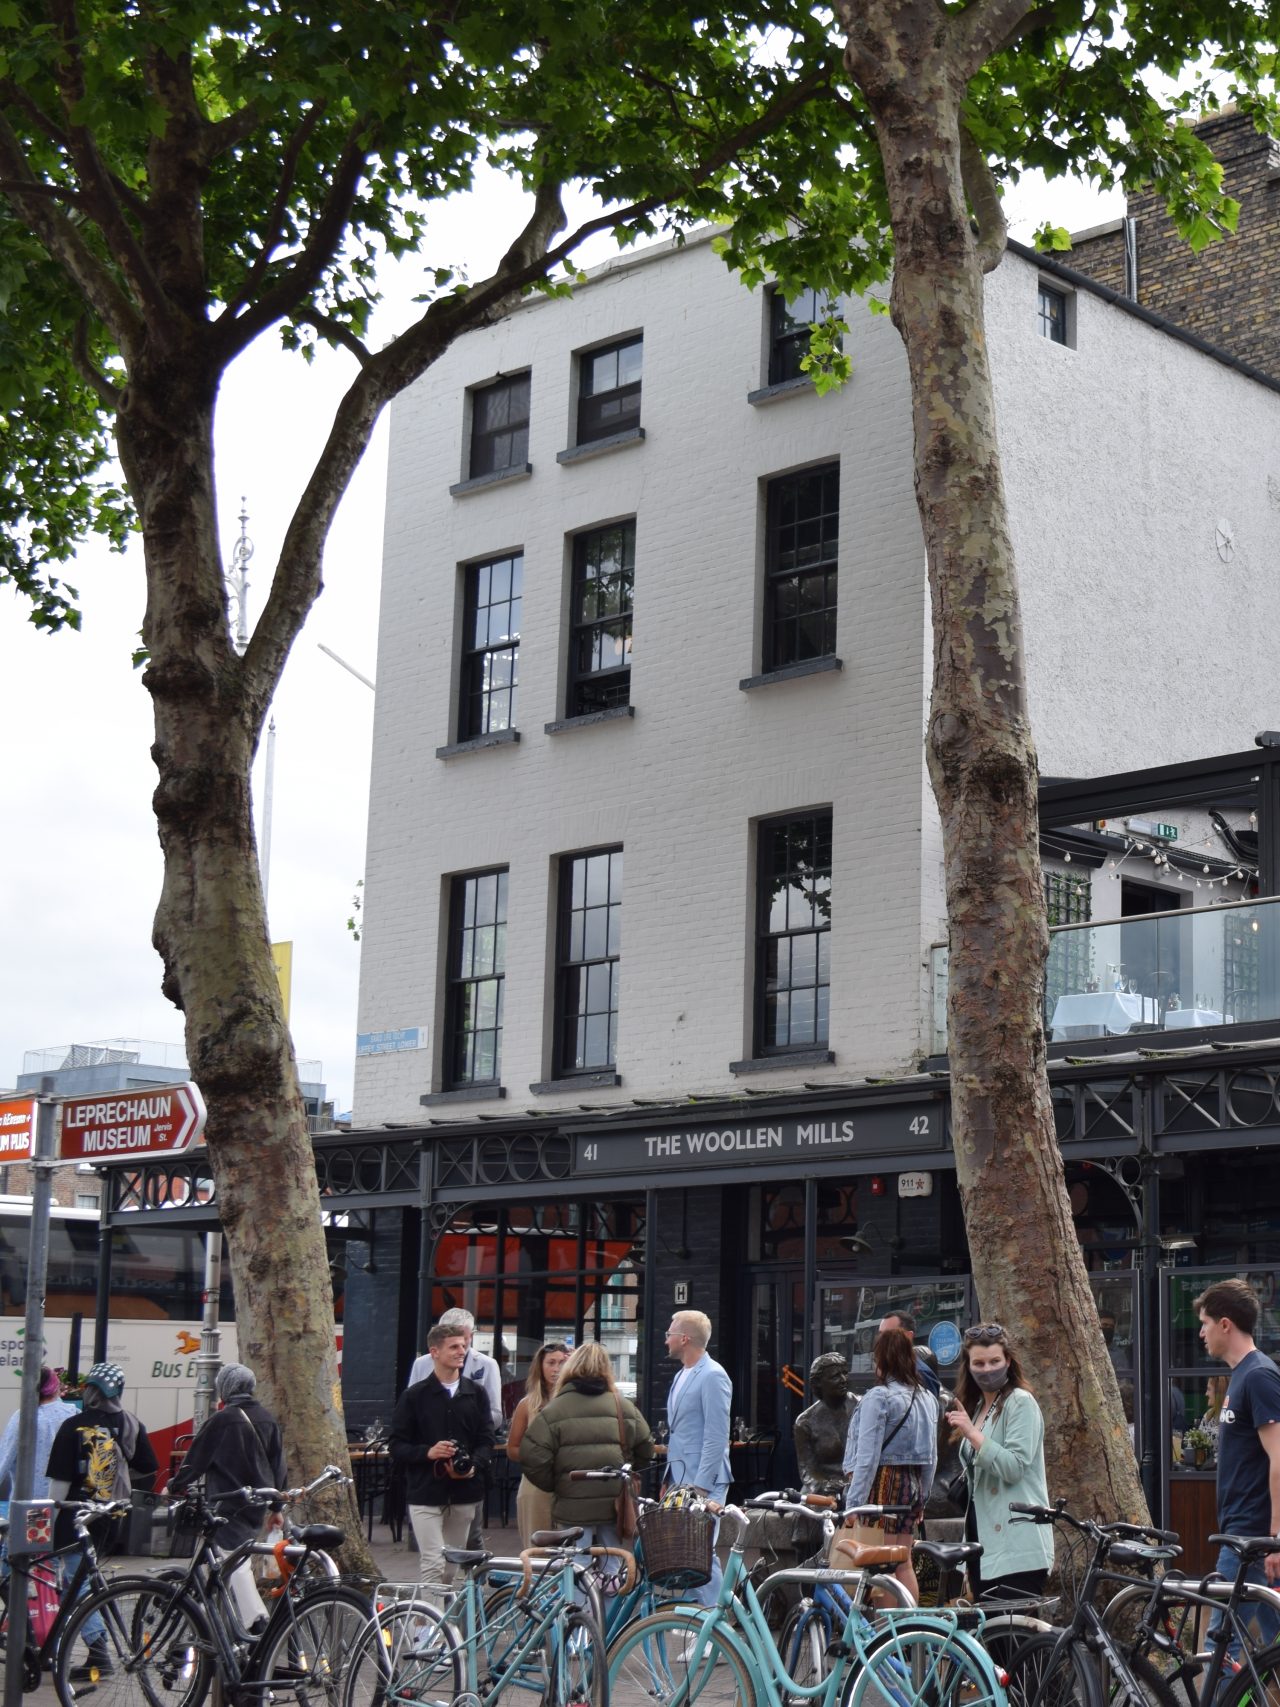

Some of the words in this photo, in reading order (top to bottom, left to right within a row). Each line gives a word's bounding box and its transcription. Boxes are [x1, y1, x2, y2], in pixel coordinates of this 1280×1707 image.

[66, 1096, 172, 1128] LEPRECHAUN
[154, 1123, 173, 1132] Jervis
[11, 1132, 30, 1151] PLUS
[83, 1125, 151, 1152] MUSEUM
[584, 1144, 598, 1161] 41
[645, 1135, 681, 1157] THE
[686, 1126, 783, 1153] WOOLLEN
[796, 1121, 854, 1146] MILLS
[909, 1116, 929, 1135] 42
[901, 1178, 914, 1188] 911
[152, 1361, 183, 1378] Bus
